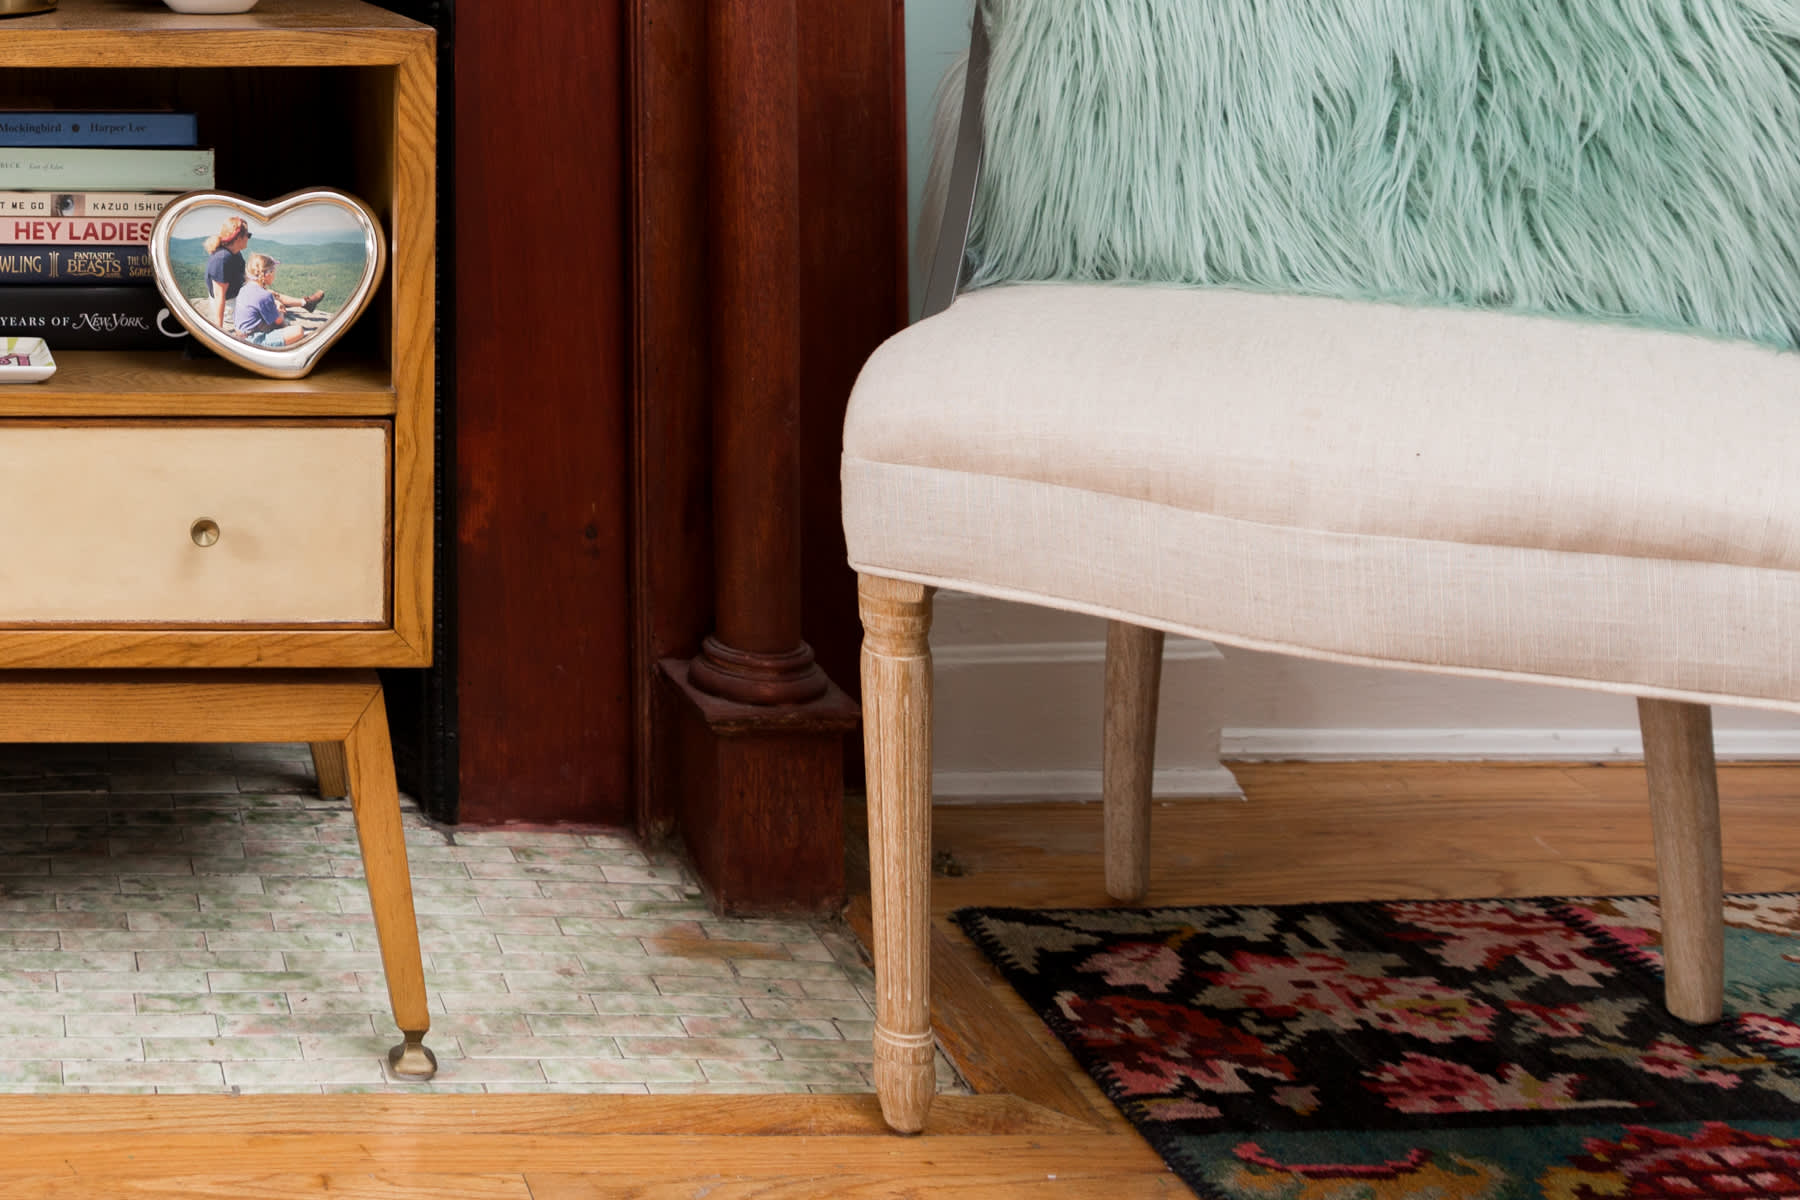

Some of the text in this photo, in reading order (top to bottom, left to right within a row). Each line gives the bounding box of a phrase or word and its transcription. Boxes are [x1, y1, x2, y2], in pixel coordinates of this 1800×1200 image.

[90, 123, 126, 134] Harper
[128, 123, 146, 133] Lee
[11, 201, 25, 210] ME
[30, 202, 45, 210] GO
[93, 202, 129, 211] KAZUO
[134, 202, 165, 211] ISHIG
[15, 221, 152, 241] HEY LADIES
[74, 251, 116, 260] FANTASTIC
[67, 258, 122, 277] BEASTS
[0, 316, 46, 327] YEARS
[51, 316, 70, 327] OF
